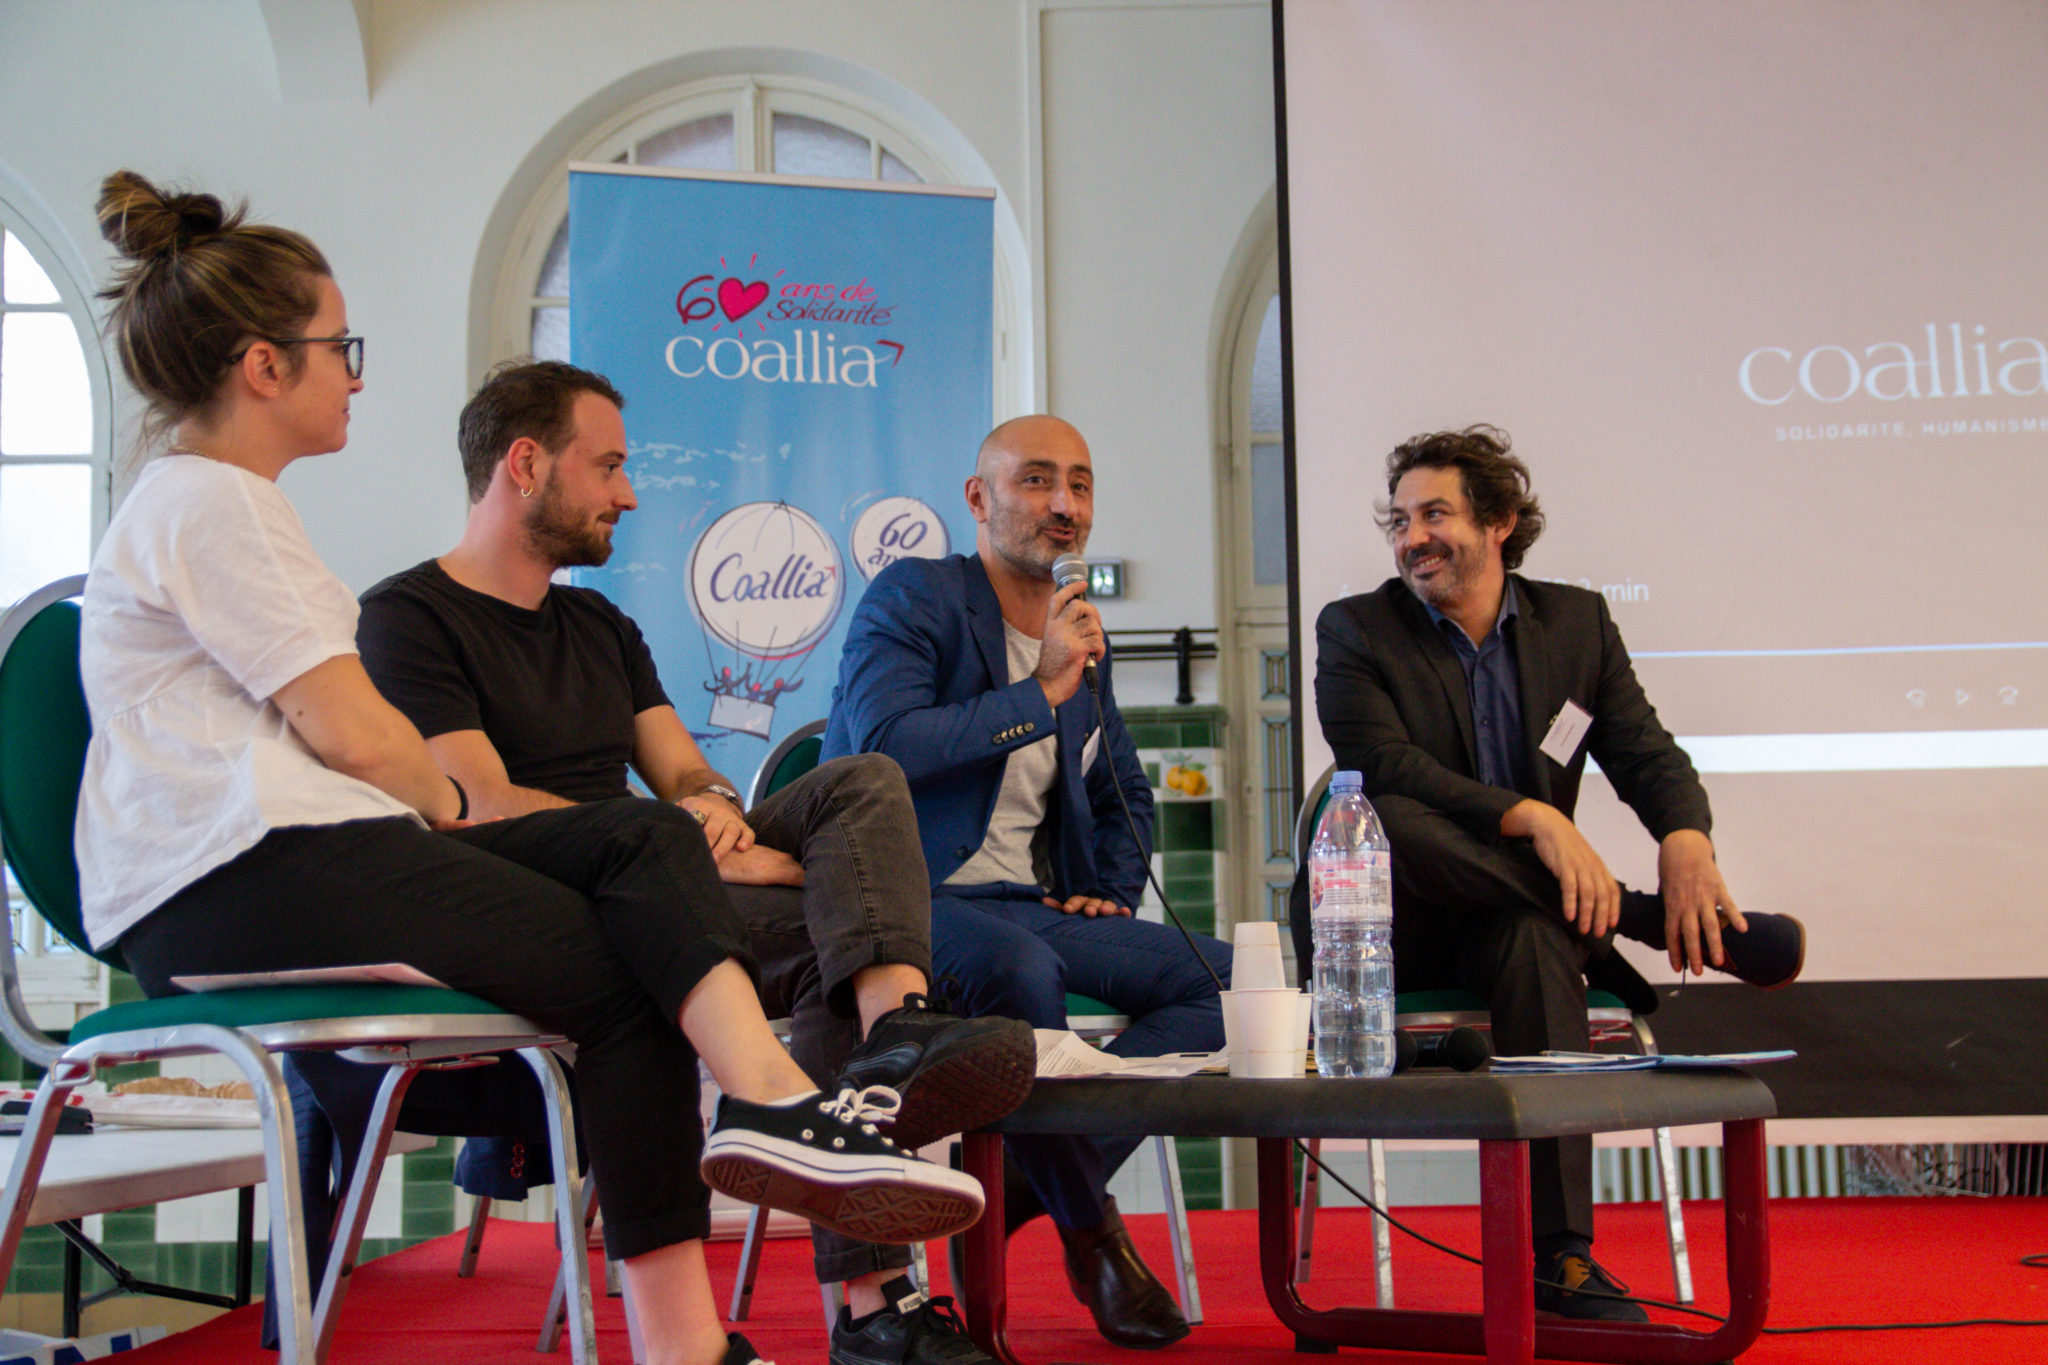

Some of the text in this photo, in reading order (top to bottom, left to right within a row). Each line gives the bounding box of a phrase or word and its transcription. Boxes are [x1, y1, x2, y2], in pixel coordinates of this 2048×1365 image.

[779, 277, 880, 302] ans de
[767, 299, 899, 326] Solidarité
[665, 328, 879, 388] coallia
[1738, 322, 2048, 405] coallia
[878, 512, 928, 550] 60
[867, 546, 899, 568] an
[710, 552, 828, 603] Coallia
[1601, 577, 1650, 602] min
